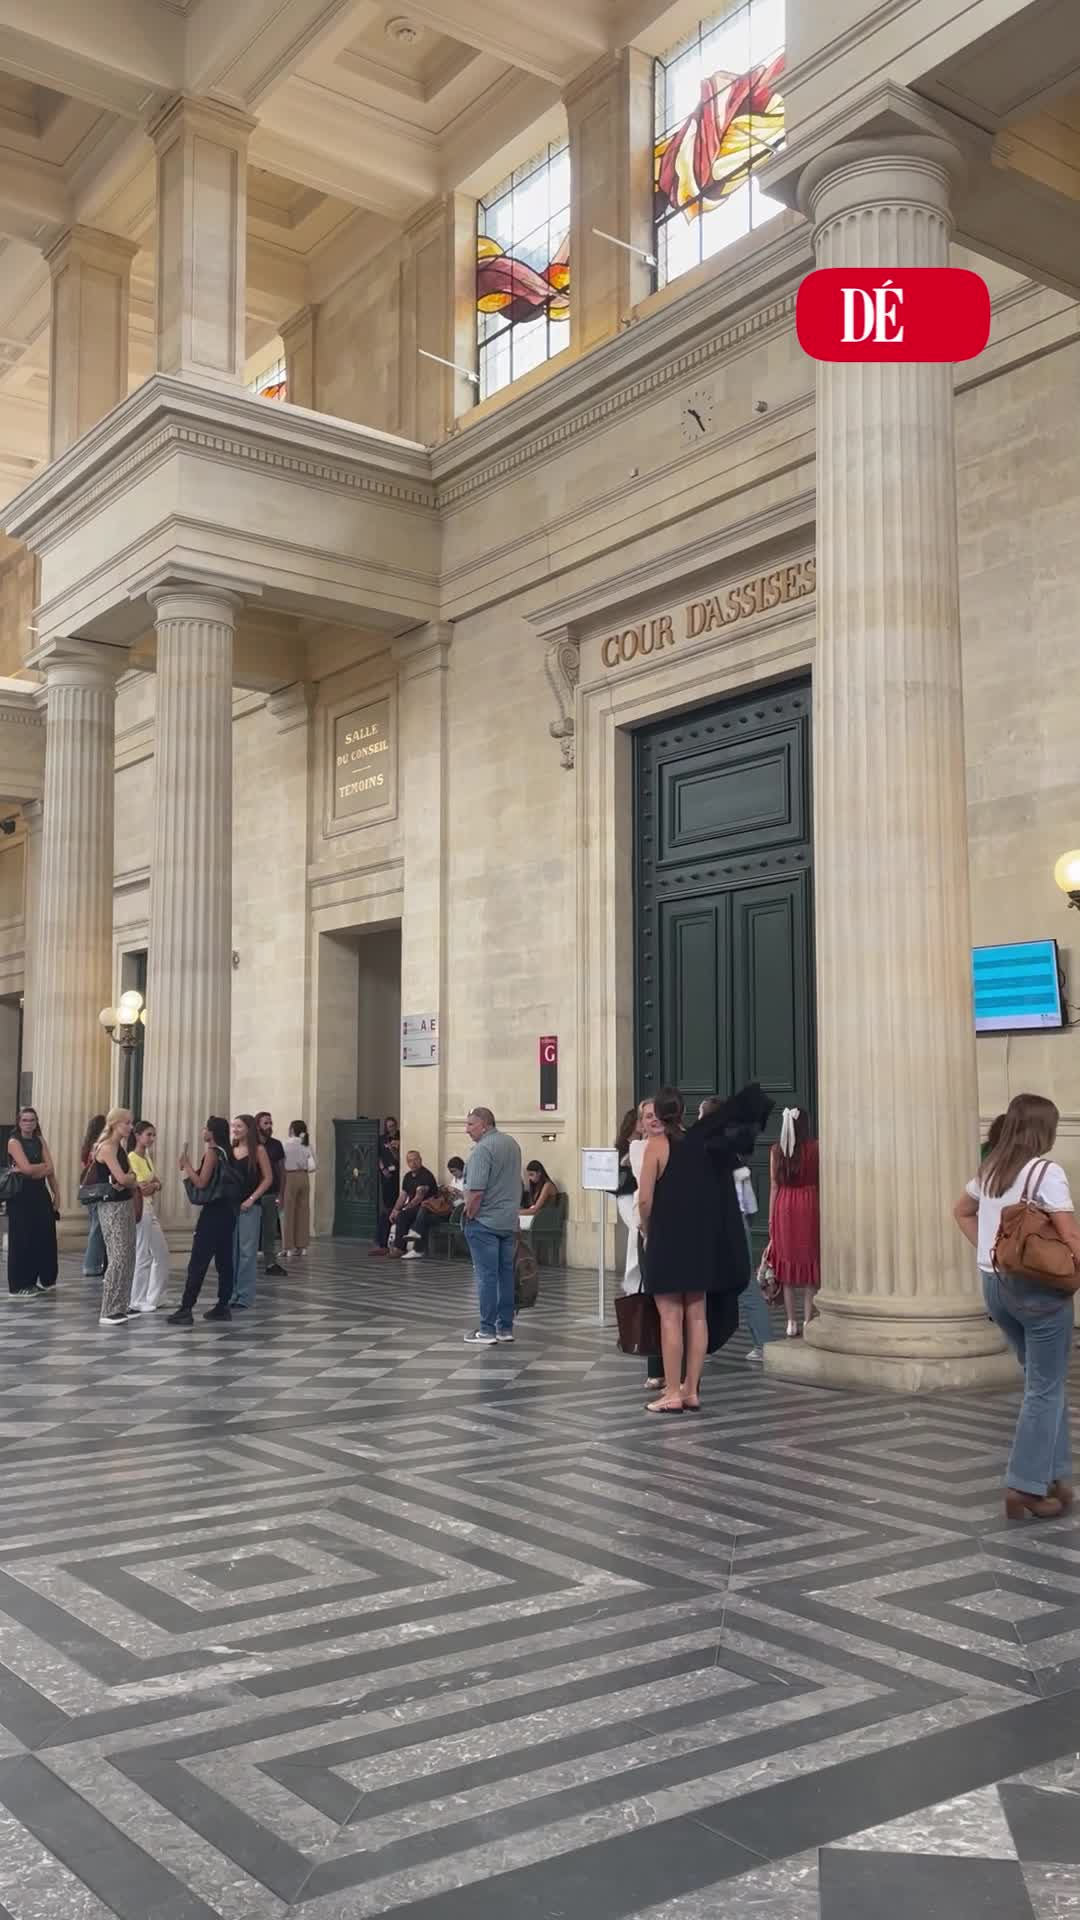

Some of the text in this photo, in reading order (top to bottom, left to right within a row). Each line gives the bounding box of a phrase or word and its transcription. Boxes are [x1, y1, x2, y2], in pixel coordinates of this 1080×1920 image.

[601, 557, 816, 668] COUR D'ASSISES
[344, 723, 378, 745] SALLE
[336, 739, 389, 767] DU CONSEIL
[339, 773, 384, 798] TEMOINS
[430, 1018, 437, 1031] E
[430, 1044, 437, 1057] F
[544, 1045, 556, 1062] G
